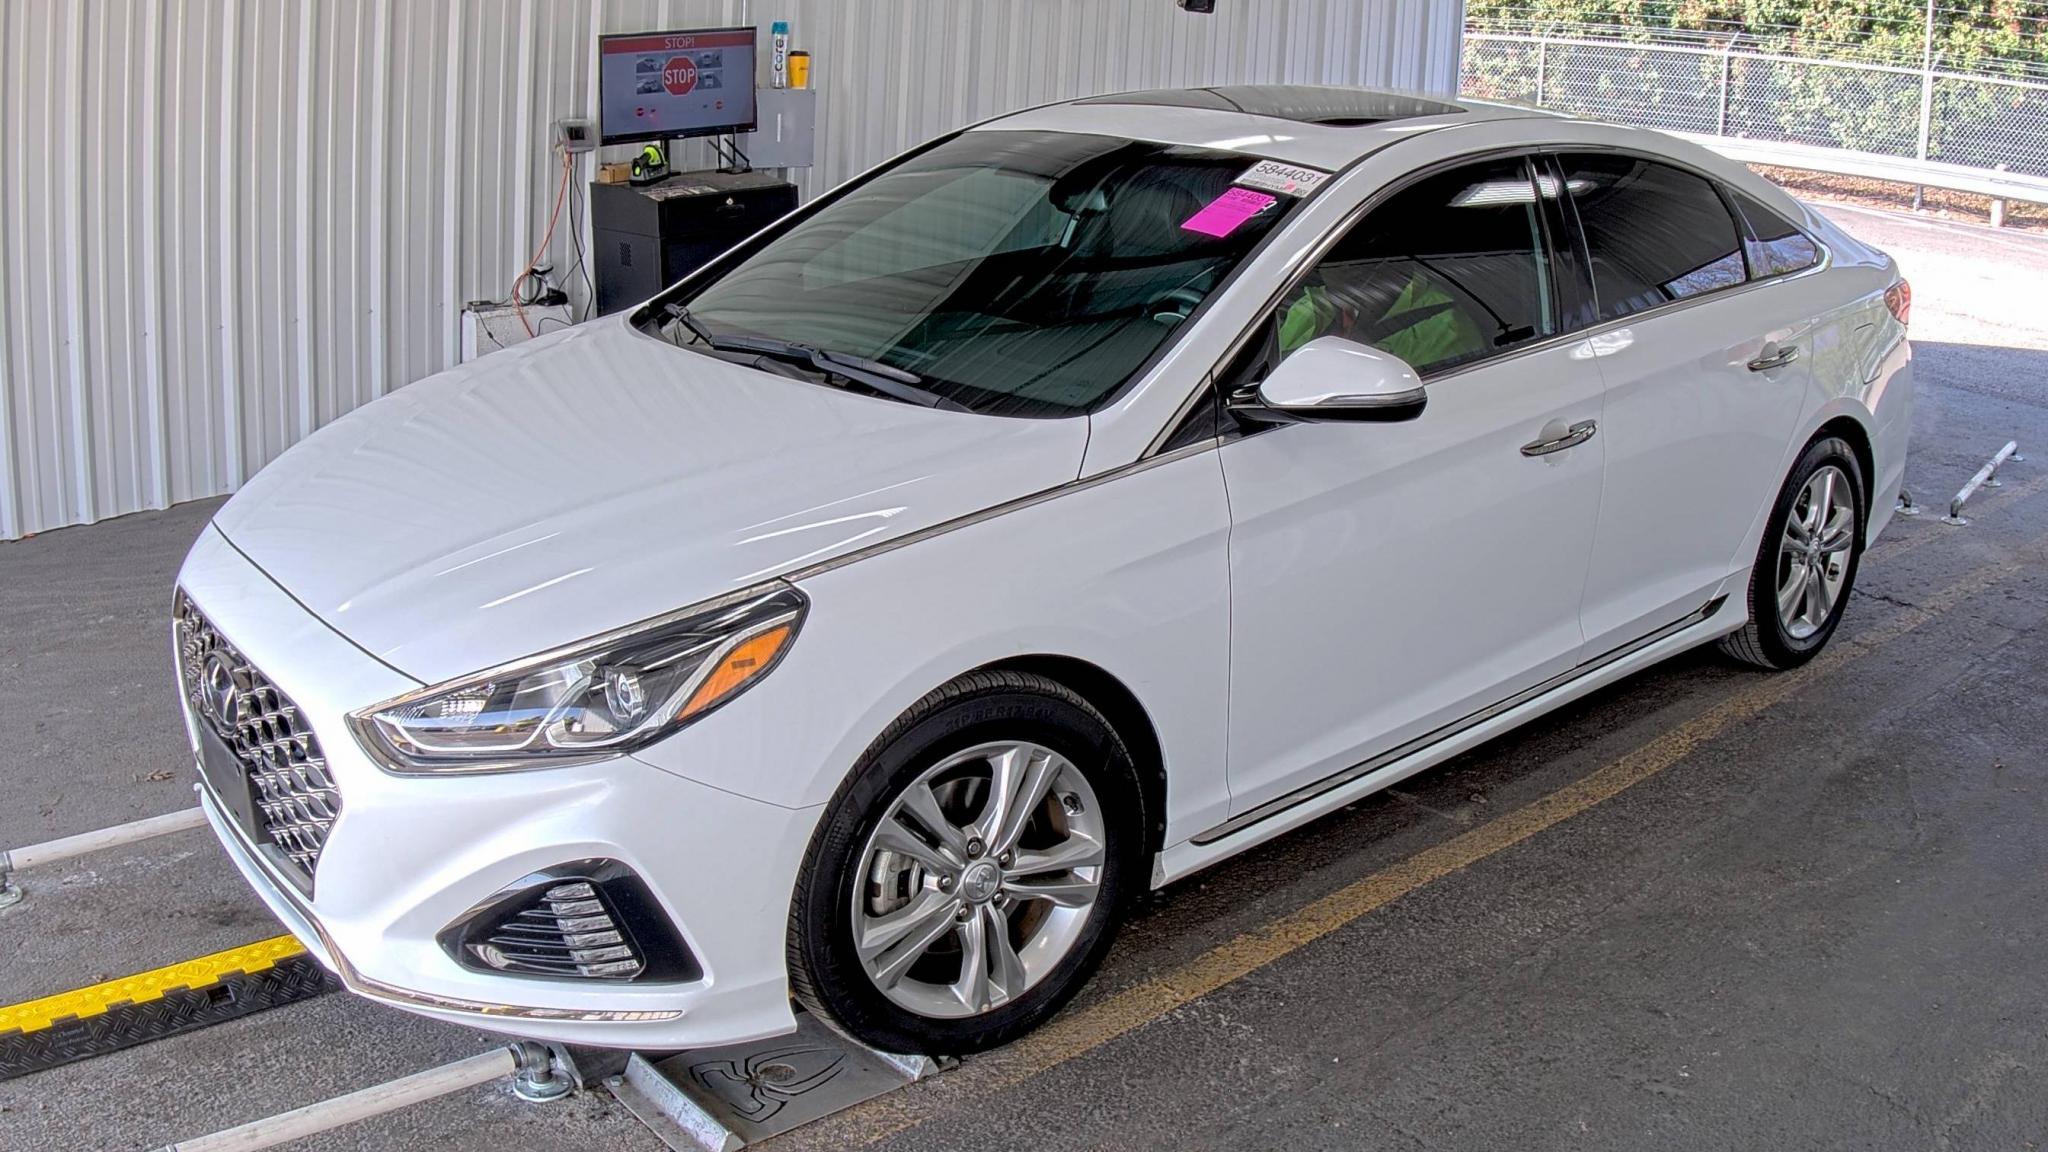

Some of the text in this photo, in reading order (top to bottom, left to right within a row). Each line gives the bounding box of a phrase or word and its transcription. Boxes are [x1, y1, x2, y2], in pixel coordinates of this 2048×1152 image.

[665, 38, 695, 49] STOP!
[775, 38, 784, 72] core
[665, 68, 695, 85] STOP
[1256, 164, 1323, 184] 5844031
